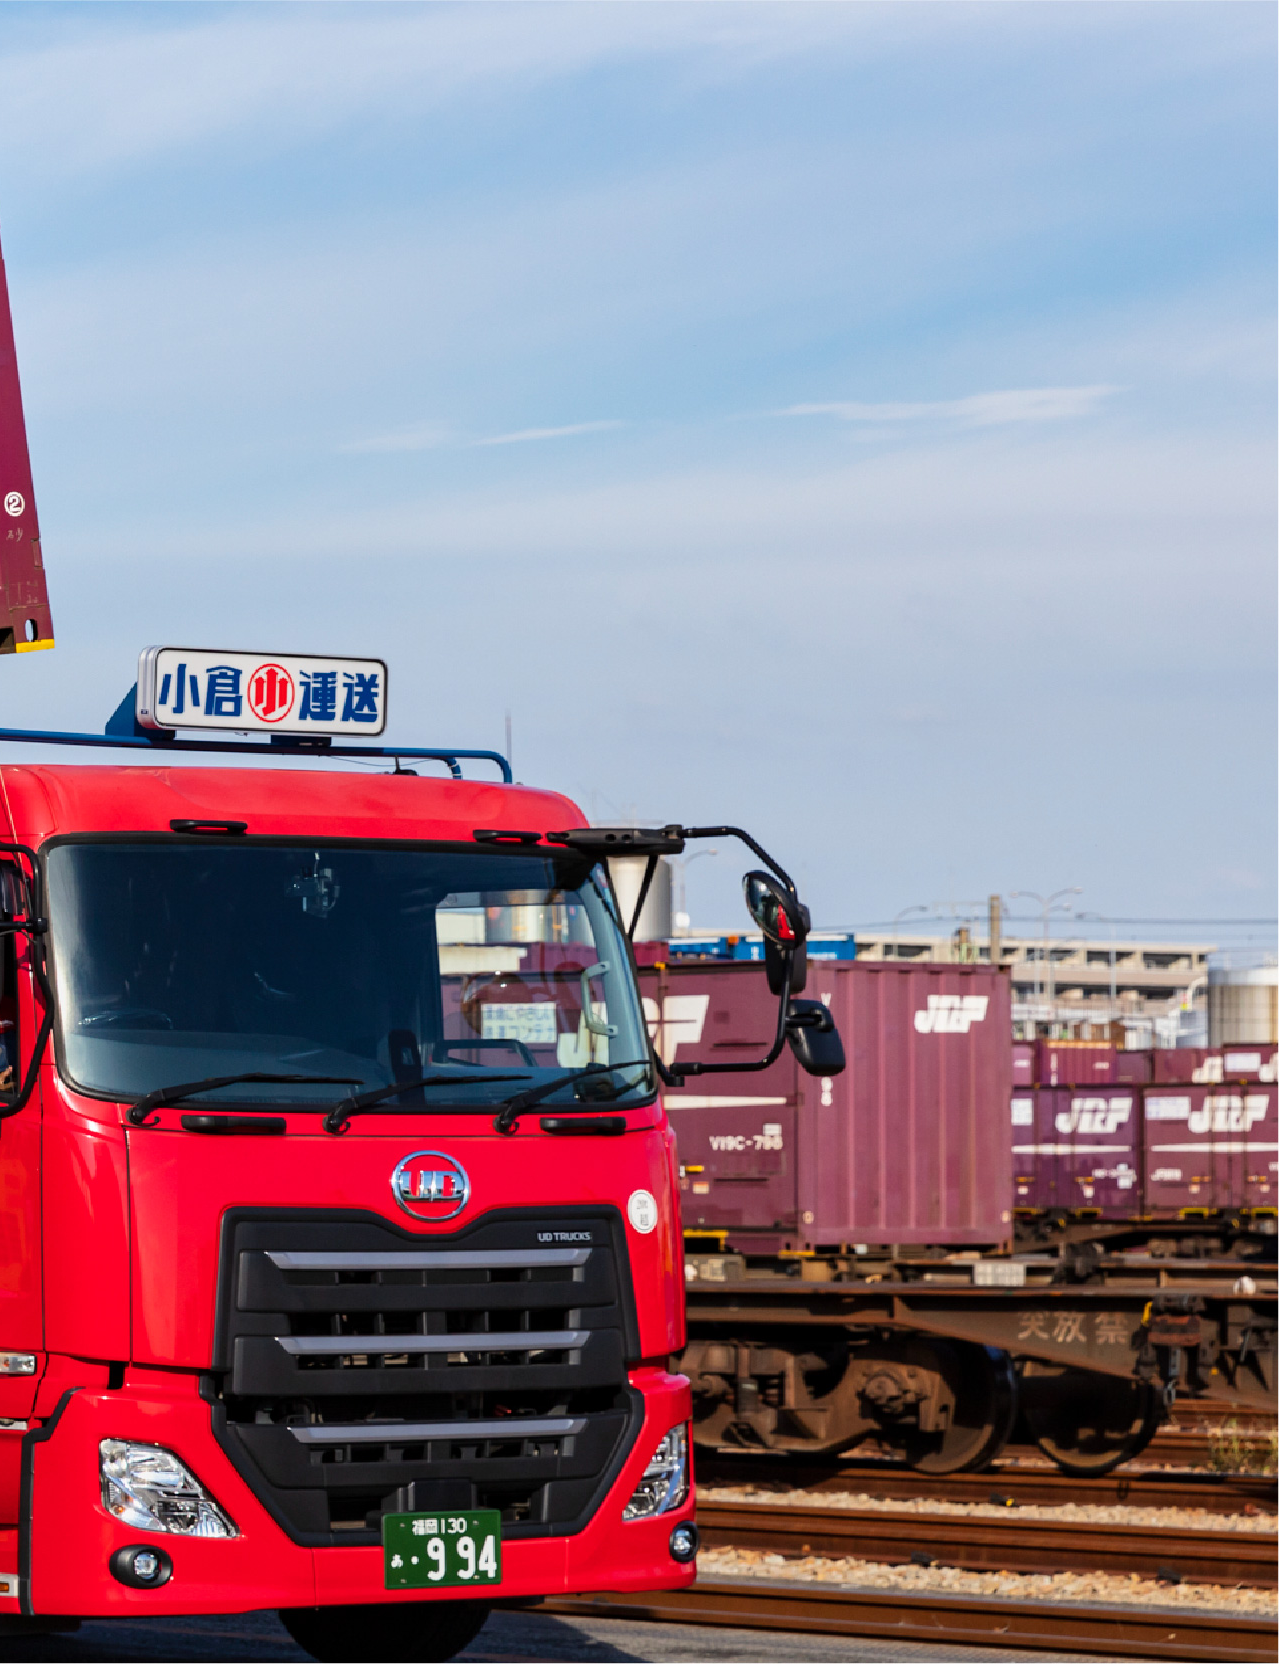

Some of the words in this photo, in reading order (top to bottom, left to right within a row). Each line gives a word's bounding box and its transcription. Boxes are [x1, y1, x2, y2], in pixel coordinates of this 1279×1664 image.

[914, 995, 989, 1033] JRF
[1055, 1097, 1133, 1133] JRF
[1188, 1094, 1270, 1133] JRF
[399, 1170, 465, 1202] UD
[537, 1231, 552, 1242] UD
[553, 1231, 591, 1242] TRUCKS
